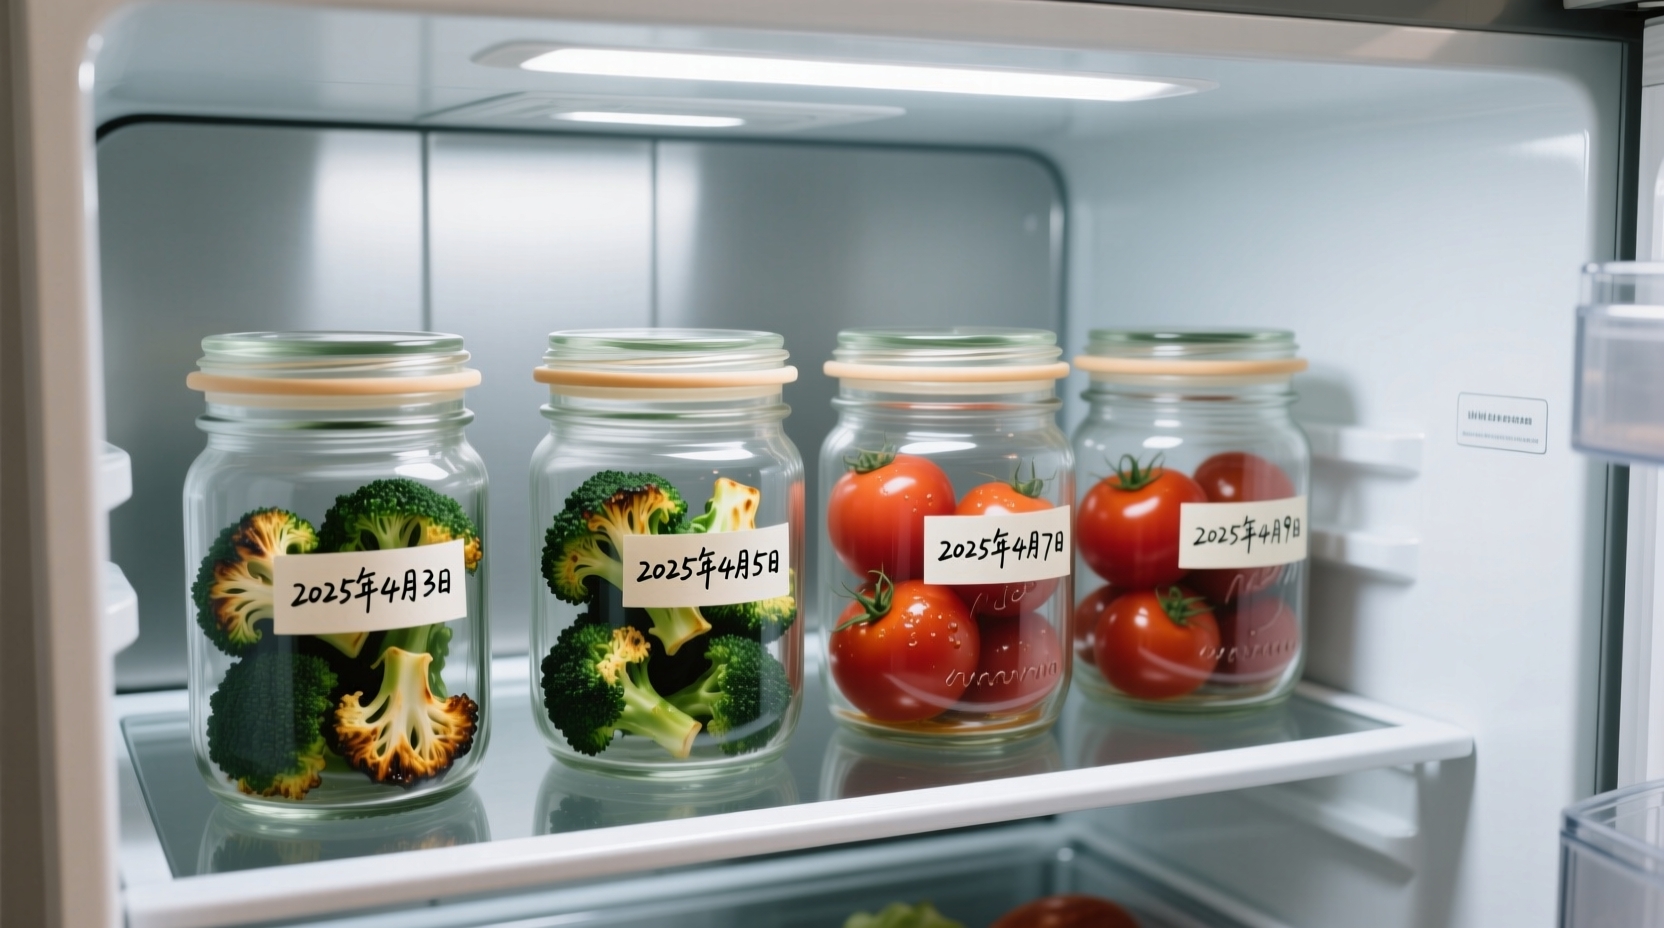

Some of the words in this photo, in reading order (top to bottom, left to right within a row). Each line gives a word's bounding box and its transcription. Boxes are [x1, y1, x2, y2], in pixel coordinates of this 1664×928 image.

[937, 527, 1064, 569] 2025年4月7日
[1192, 515, 1301, 554] 2025年4月9日
[290, 566, 452, 613] 2025年4月3日
[636, 546, 780, 591] 2025年4月5日
